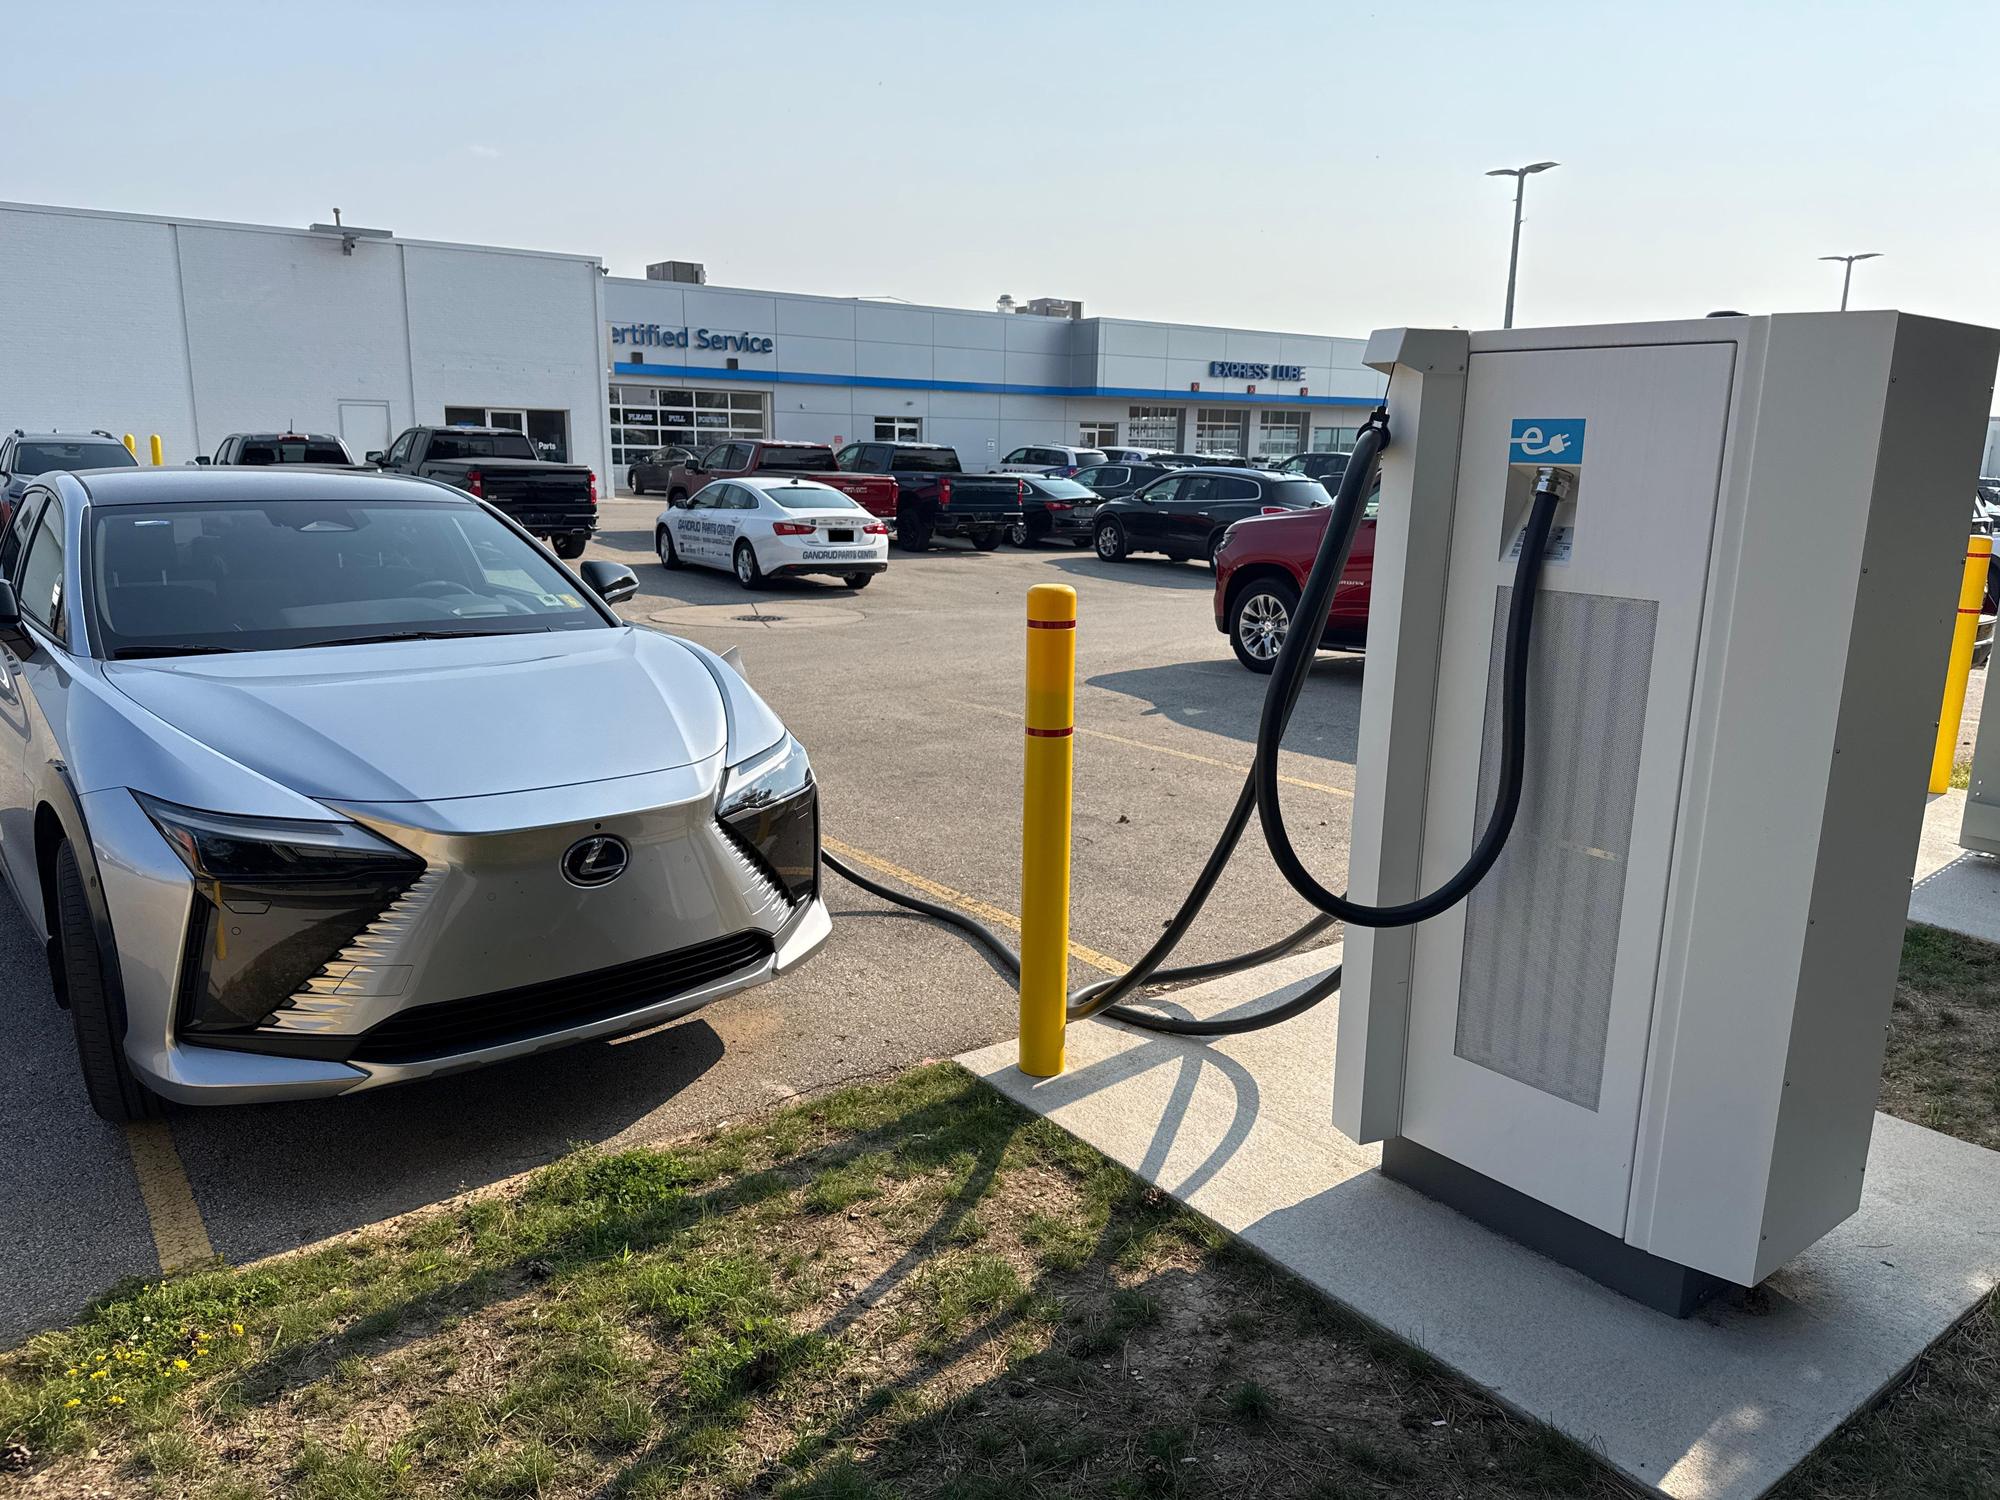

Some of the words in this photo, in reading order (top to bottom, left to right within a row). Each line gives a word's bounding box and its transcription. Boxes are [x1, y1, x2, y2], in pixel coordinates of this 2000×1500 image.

[612, 324, 689, 348] ertified
[696, 328, 774, 353] Service
[1210, 361, 1270, 380] EXPRESS
[1272, 365, 1306, 381] LUBE
[627, 413, 654, 421] PLEASE
[668, 414, 686, 423] PULL
[538, 441, 557, 450] Parts
[677, 519, 701, 533] GANDRUD
[701, 521, 717, 535] PARTS
[716, 523, 736, 537] CENTER
[802, 550, 838, 560] GANDRUD
[837, 550, 857, 559] PARTS
[857, 550, 878, 559] CENTER
